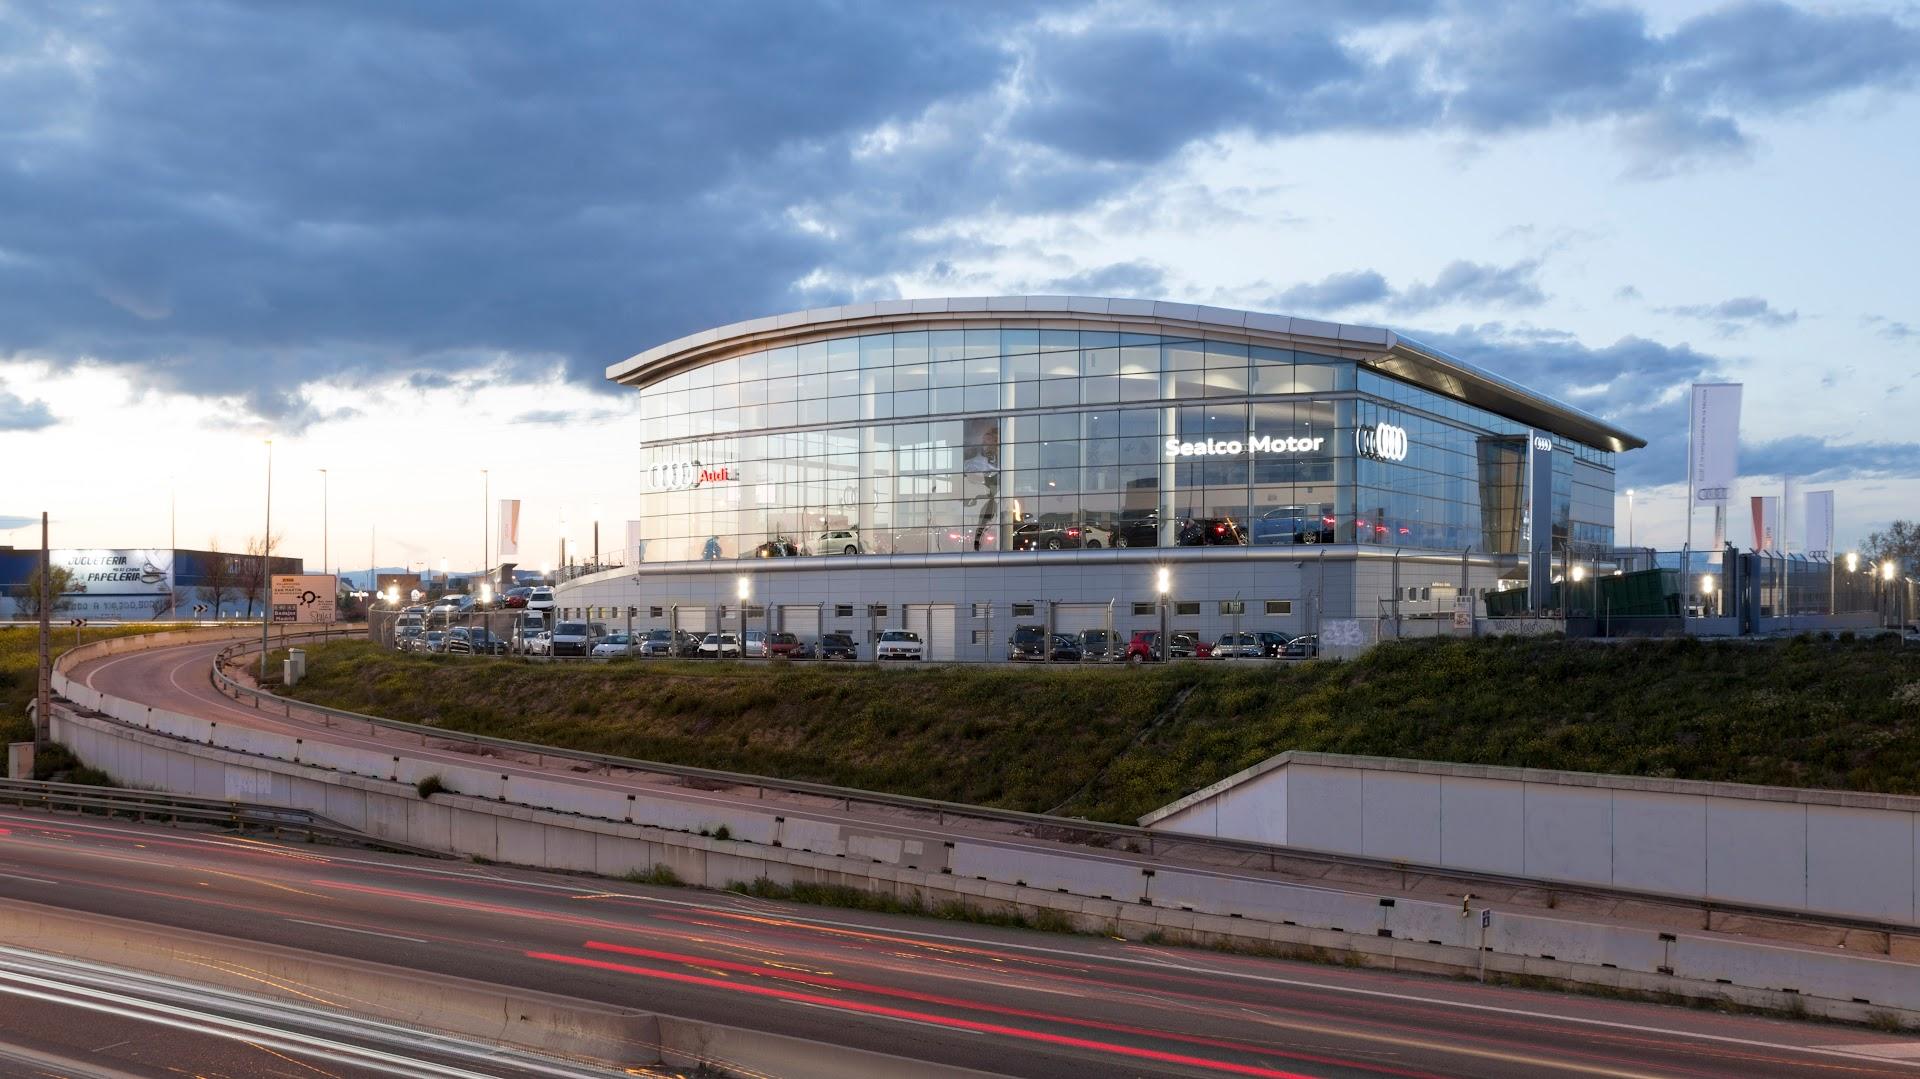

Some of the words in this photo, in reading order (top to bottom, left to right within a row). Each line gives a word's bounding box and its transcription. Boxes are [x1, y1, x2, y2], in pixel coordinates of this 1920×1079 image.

[1165, 438, 1242, 457] Sealco
[1249, 435, 1324, 453] Motor
[699, 467, 728, 482] Audi
[88, 572, 140, 581] PAPELERIA
